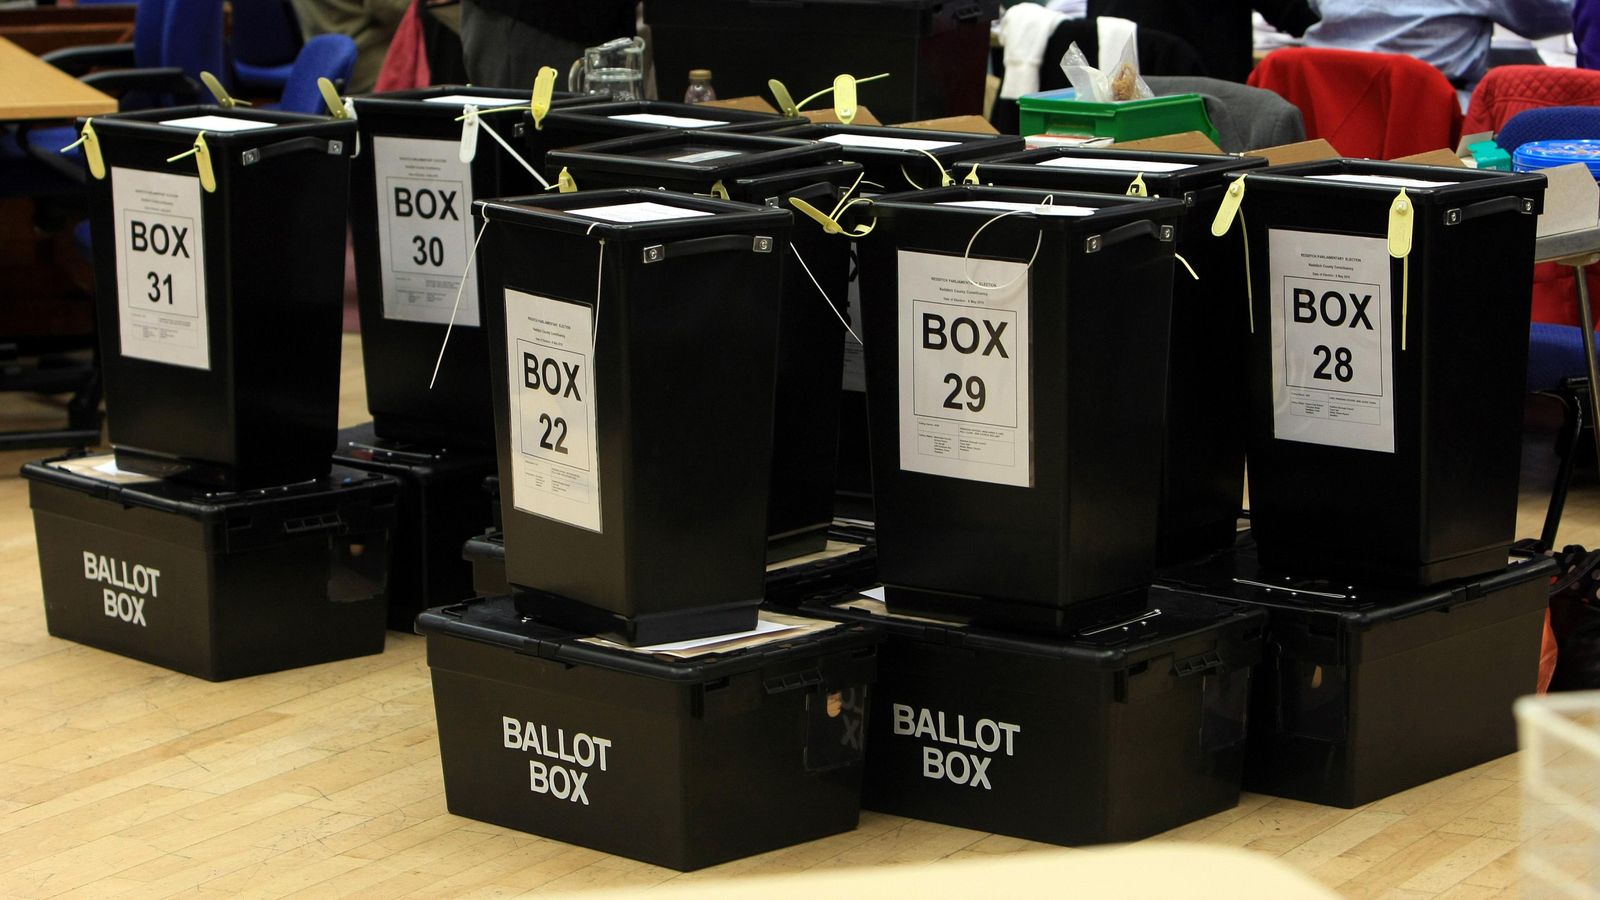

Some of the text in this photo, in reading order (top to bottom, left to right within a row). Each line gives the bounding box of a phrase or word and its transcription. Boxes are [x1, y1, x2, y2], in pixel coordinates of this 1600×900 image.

[394, 187, 459, 221] BOX
[131, 220, 190, 259] BOX
[412, 235, 444, 267] 30
[147, 271, 173, 305] 31
[1293, 287, 1374, 330] BOX
[923, 312, 1009, 359] BOX
[523, 351, 582, 402] BOX
[1313, 345, 1354, 383] 28
[943, 373, 986, 413] 29
[539, 413, 569, 455] 22
[83, 551, 160, 598] BALLOT
[103, 588, 147, 627] BOX
[502, 715, 612, 771] BALLOT
[893, 703, 1021, 756] BALLOT
[529, 760, 589, 806] BOX
[923, 746, 992, 790] BOX
